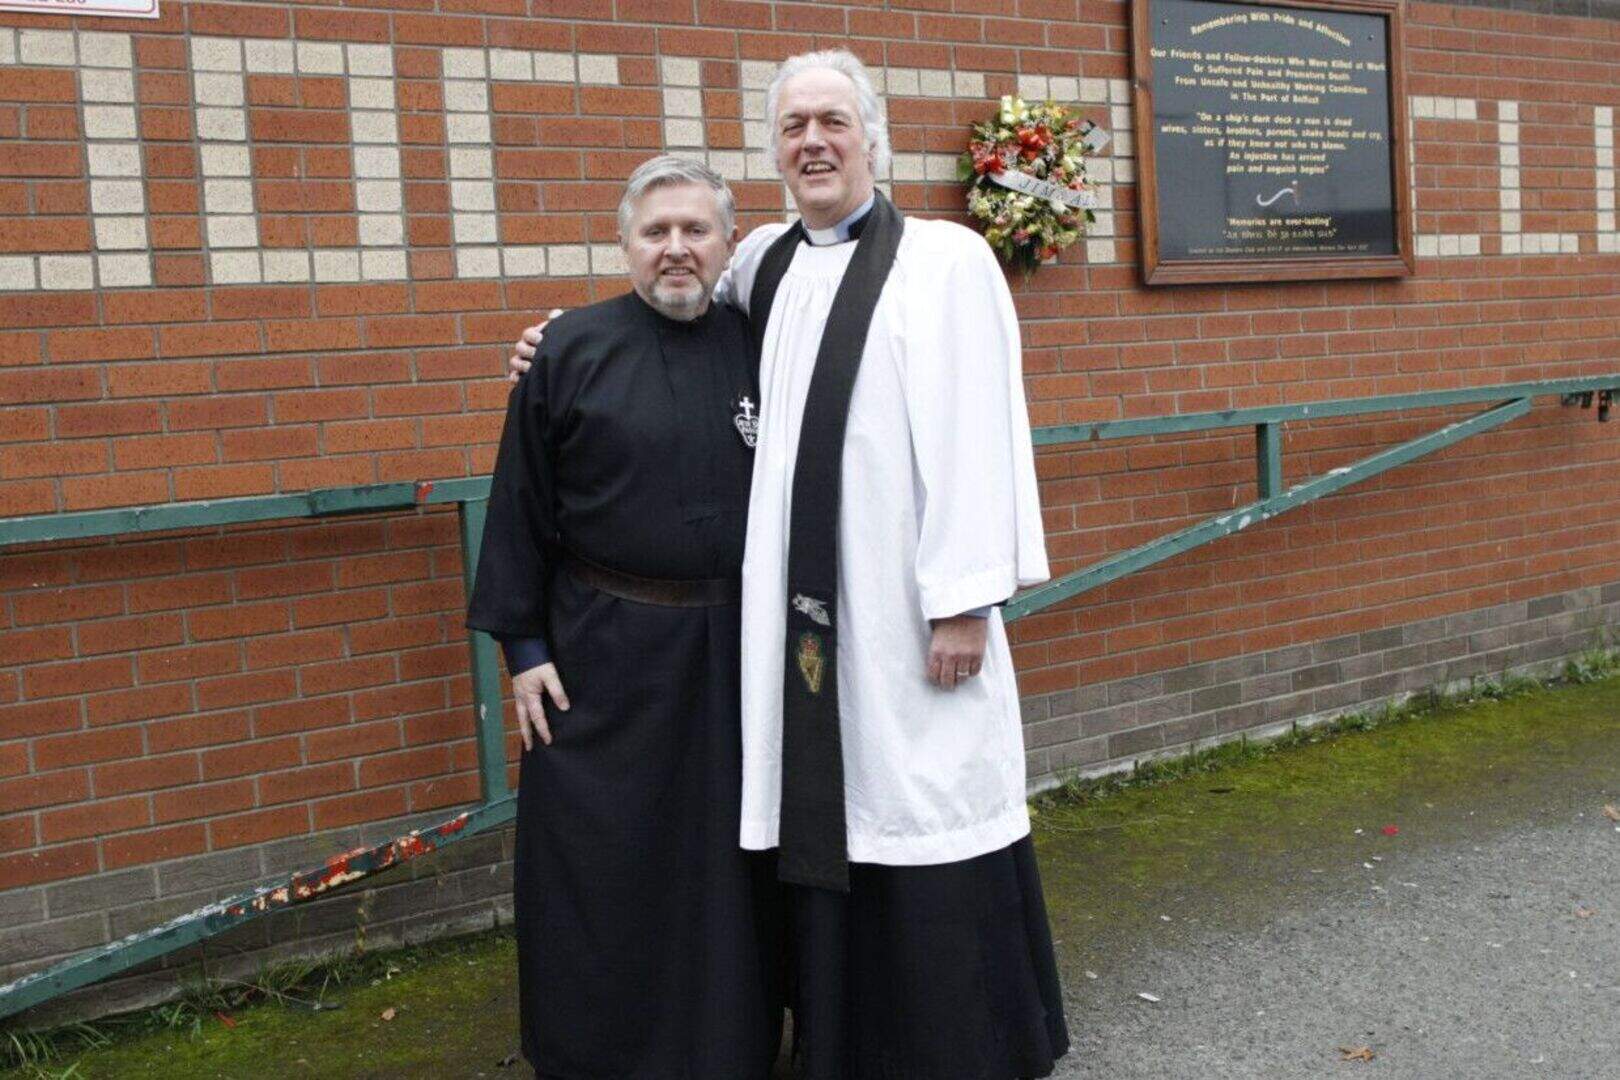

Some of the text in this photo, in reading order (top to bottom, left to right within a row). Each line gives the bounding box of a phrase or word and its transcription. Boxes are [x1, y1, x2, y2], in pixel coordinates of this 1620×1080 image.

[1190, 12, 1350, 46] Remembering With Pride and Affection
[1150, 48, 1166, 58] Our
[1170, 49, 1201, 60] Friends
[1205, 52, 1221, 61] and
[1288, 57, 1305, 66] Who
[1309, 58, 1328, 67] Were
[1331, 59, 1352, 69] Killed
[1366, 61, 1386, 71] Work
[1194, 64, 1204, 73] Or
[1207, 64, 1242, 74] Suffered
[1246, 66, 1264, 76] Pain
[1267, 69, 1282, 78] and
[1175, 76, 1367, 94] From Unsafe and Unhealthy Working Conditions
[1260, 92, 1278, 102] Port
[1281, 94, 1290, 103] of
